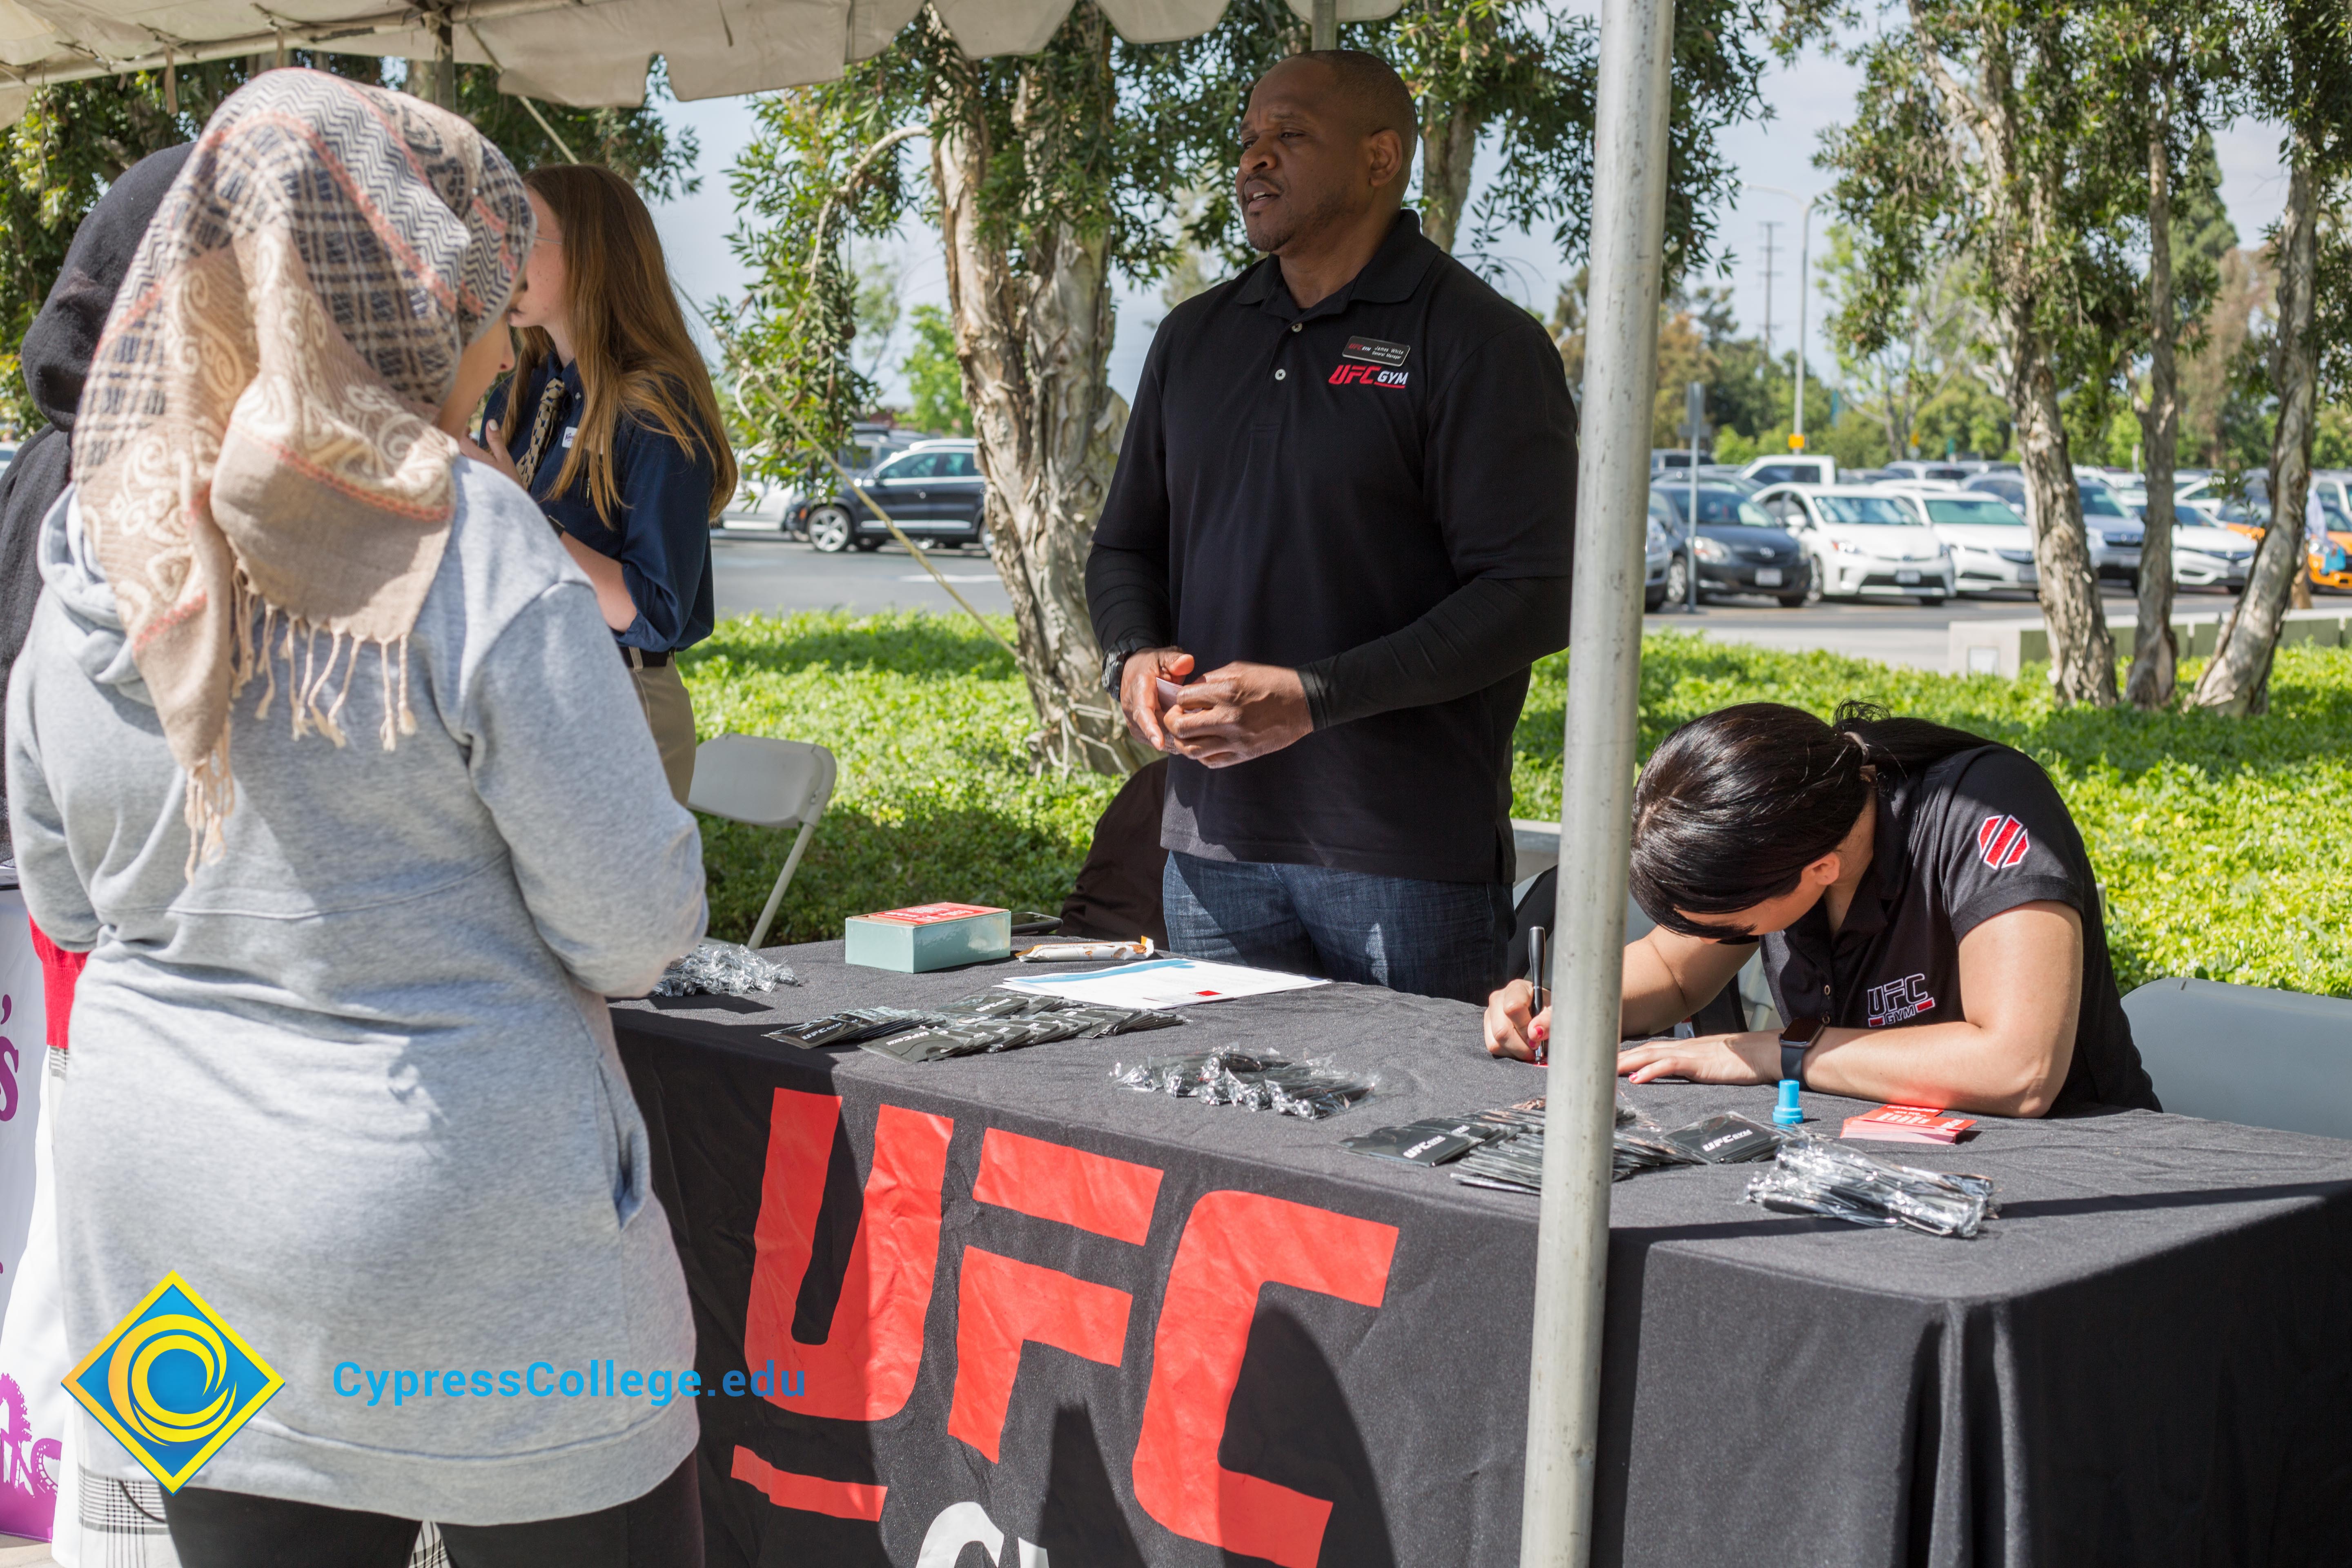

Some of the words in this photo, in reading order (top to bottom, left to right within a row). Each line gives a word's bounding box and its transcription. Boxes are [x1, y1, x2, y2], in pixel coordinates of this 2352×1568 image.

[1328, 364, 1382, 385] UFC
[1377, 370, 1409, 385] GYM
[1867, 973, 1928, 1017] UFC
[1885, 1005, 1915, 1024] GYM
[802, 1027, 827, 1040] UFC
[902, 1031, 929, 1041] UFC
[1403, 1141, 1432, 1159] UFC
[1702, 1134, 1734, 1152] UFC
[745, 1087, 1399, 1568] UFC
